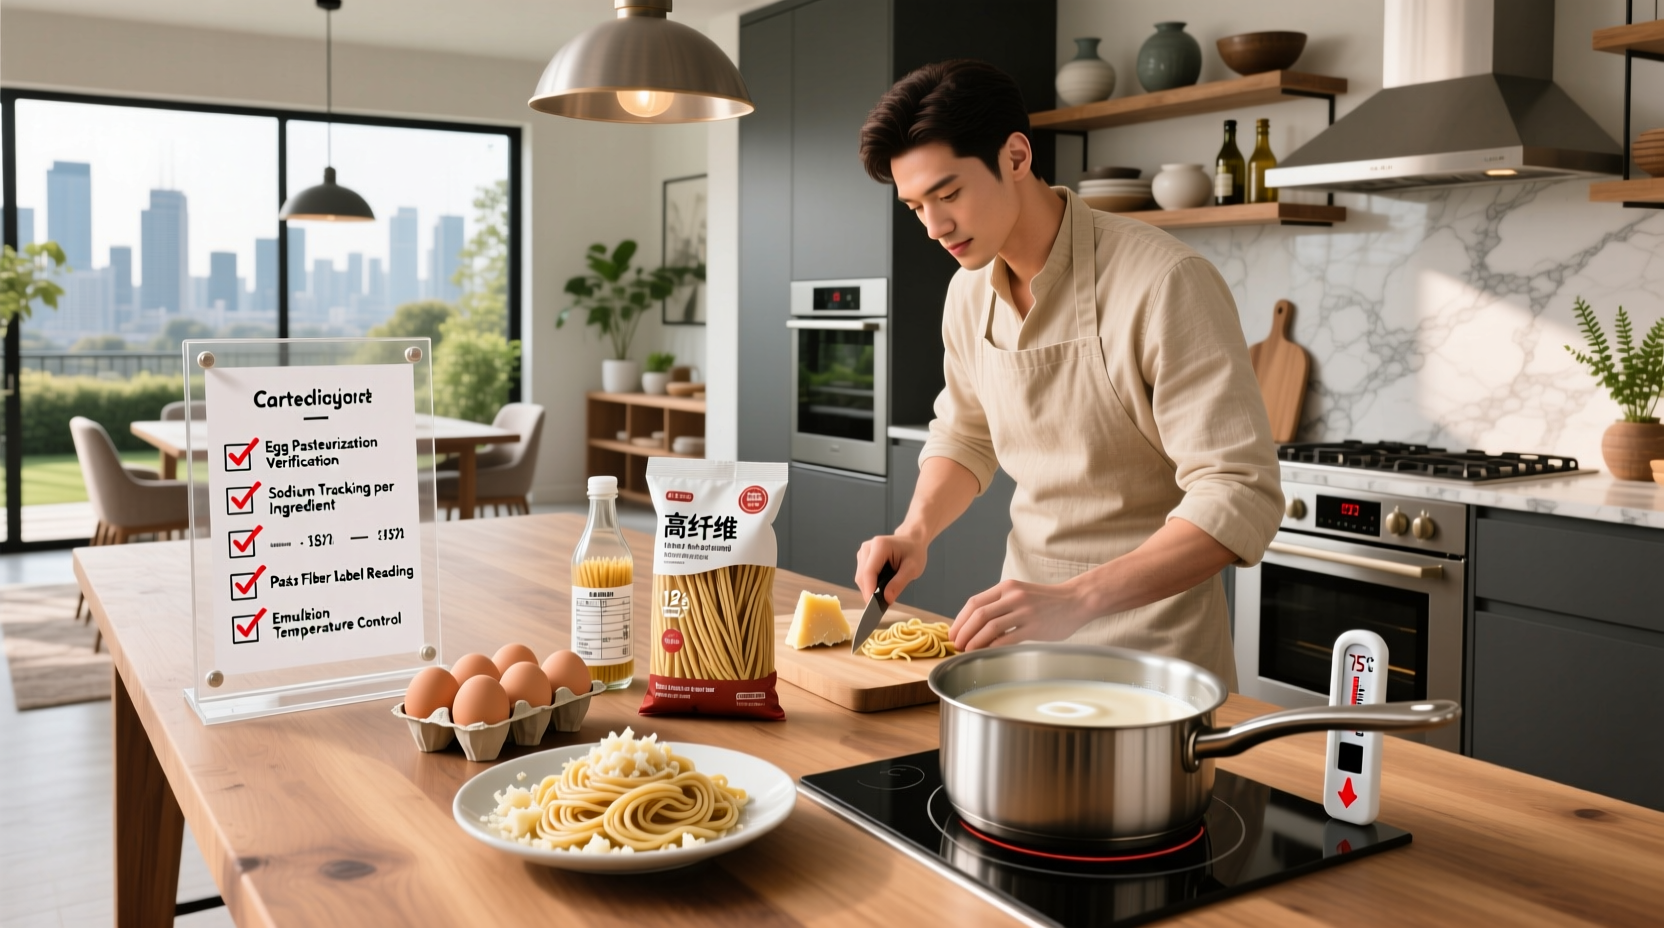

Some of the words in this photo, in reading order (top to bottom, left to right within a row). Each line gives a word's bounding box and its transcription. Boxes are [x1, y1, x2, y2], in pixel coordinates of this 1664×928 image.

[265, 440, 289, 457] Egg
[292, 436, 378, 452] Pasteurization
[266, 455, 339, 469] Verification
[269, 485, 315, 499] Sodium
[318, 481, 371, 497] Tracking
[374, 483, 395, 496] per
[269, 499, 336, 518] Ingredient
[664, 512, 738, 541] 高纤维
[367, 565, 414, 579] Reading
[273, 620, 354, 640] Temperature
[357, 611, 401, 629] Control
